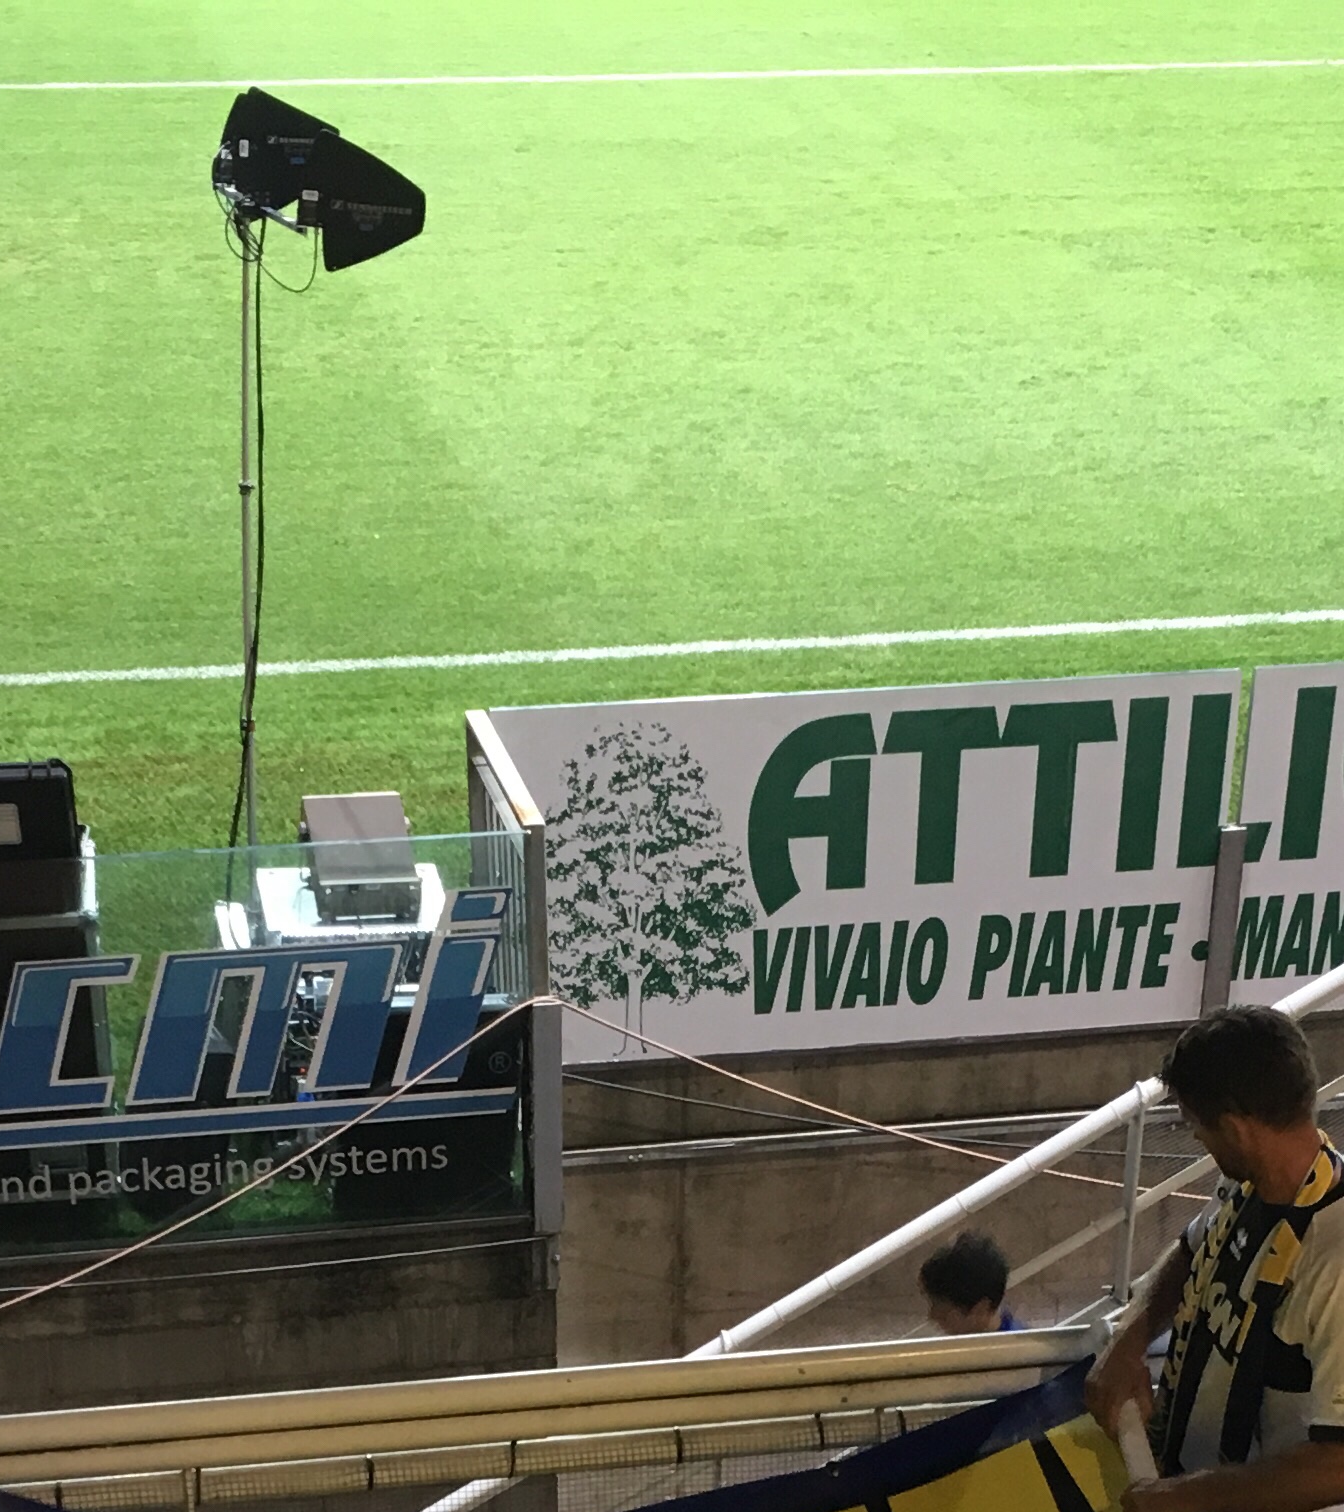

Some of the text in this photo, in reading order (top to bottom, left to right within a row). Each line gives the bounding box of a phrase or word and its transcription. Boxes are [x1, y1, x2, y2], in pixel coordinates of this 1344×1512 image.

[753, 916, 950, 1015] VIVAIO
[967, 902, 1181, 1001] PIANTE
[68, 1154, 275, 1205] packaging
[288, 1143, 449, 1186] systems
